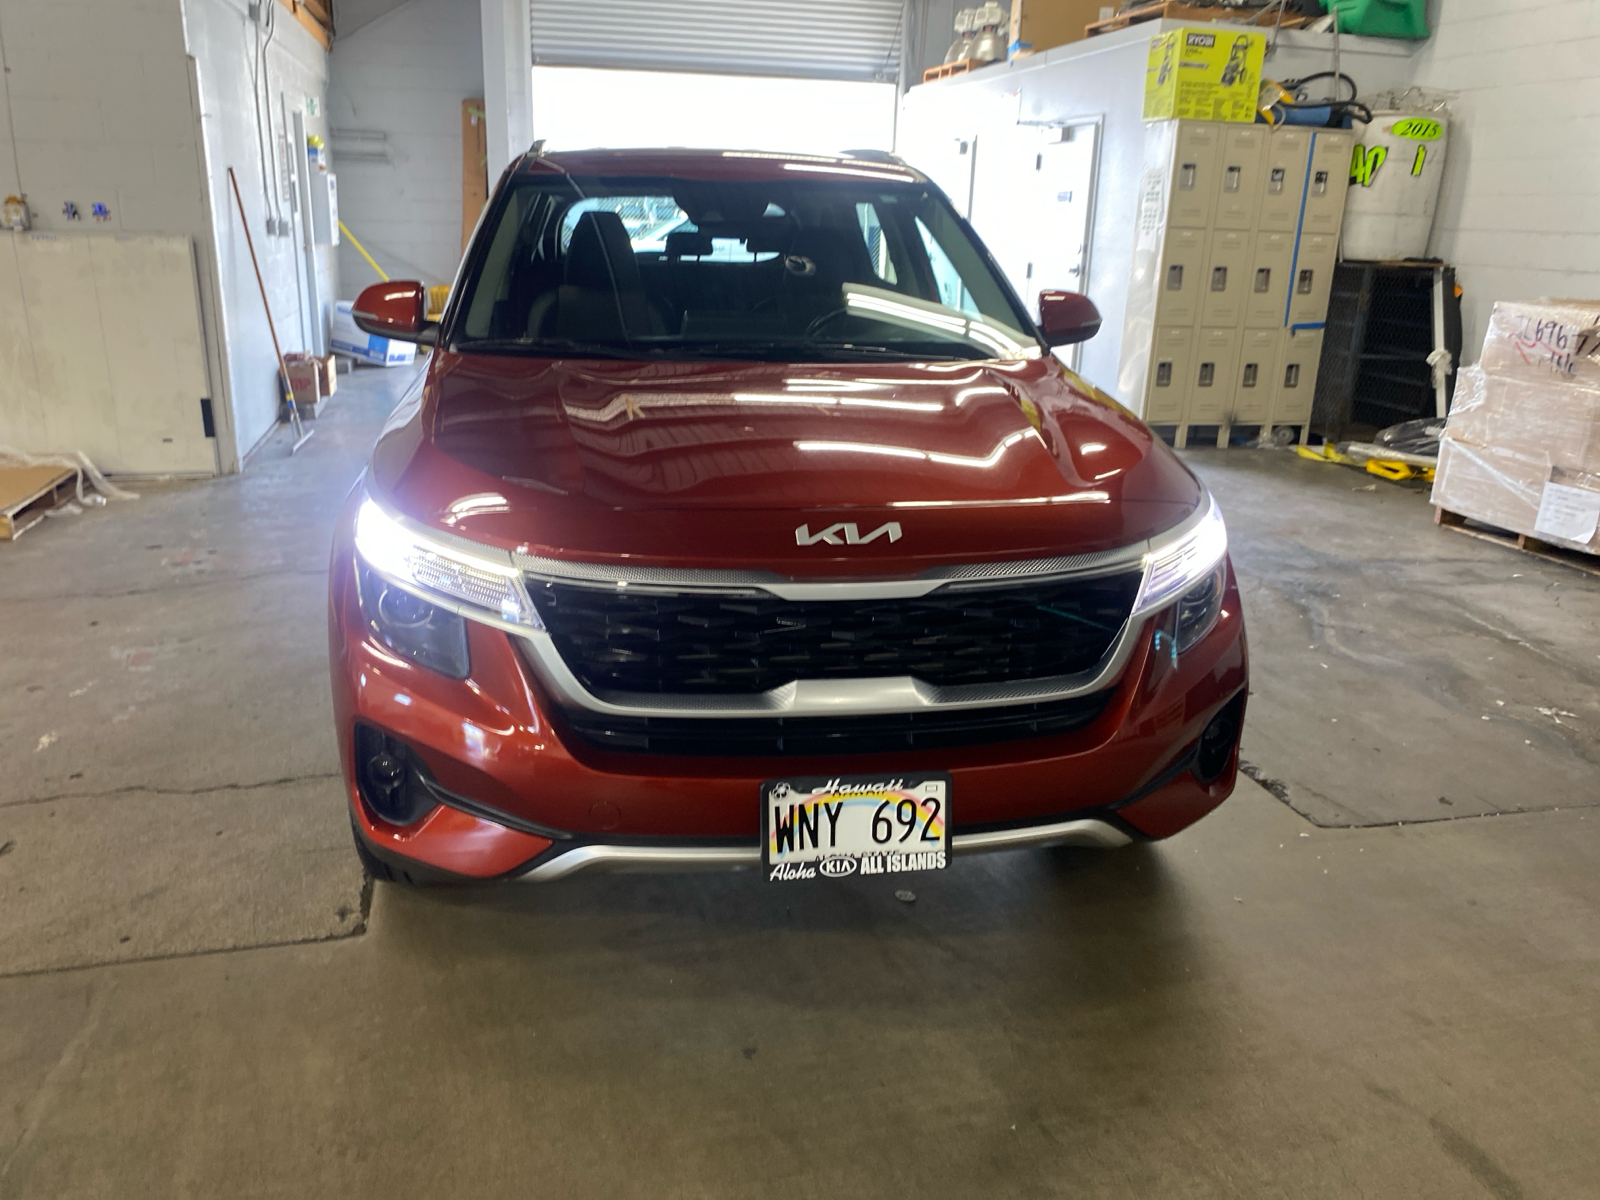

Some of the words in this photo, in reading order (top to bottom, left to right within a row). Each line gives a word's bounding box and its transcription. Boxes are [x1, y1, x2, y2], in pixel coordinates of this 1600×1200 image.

[1187, 34, 1214, 46] RYOBI
[1400, 121, 1439, 137] 2015
[795, 521, 902, 546] KIA
[812, 778, 903, 794] Hawaii
[775, 801, 843, 853] WNY
[871, 797, 941, 844] 692
[770, 862, 816, 881] Aloha
[824, 859, 852, 874] KIA
[861, 856, 884, 875] ALL
[887, 851, 946, 872] ISLANDS
